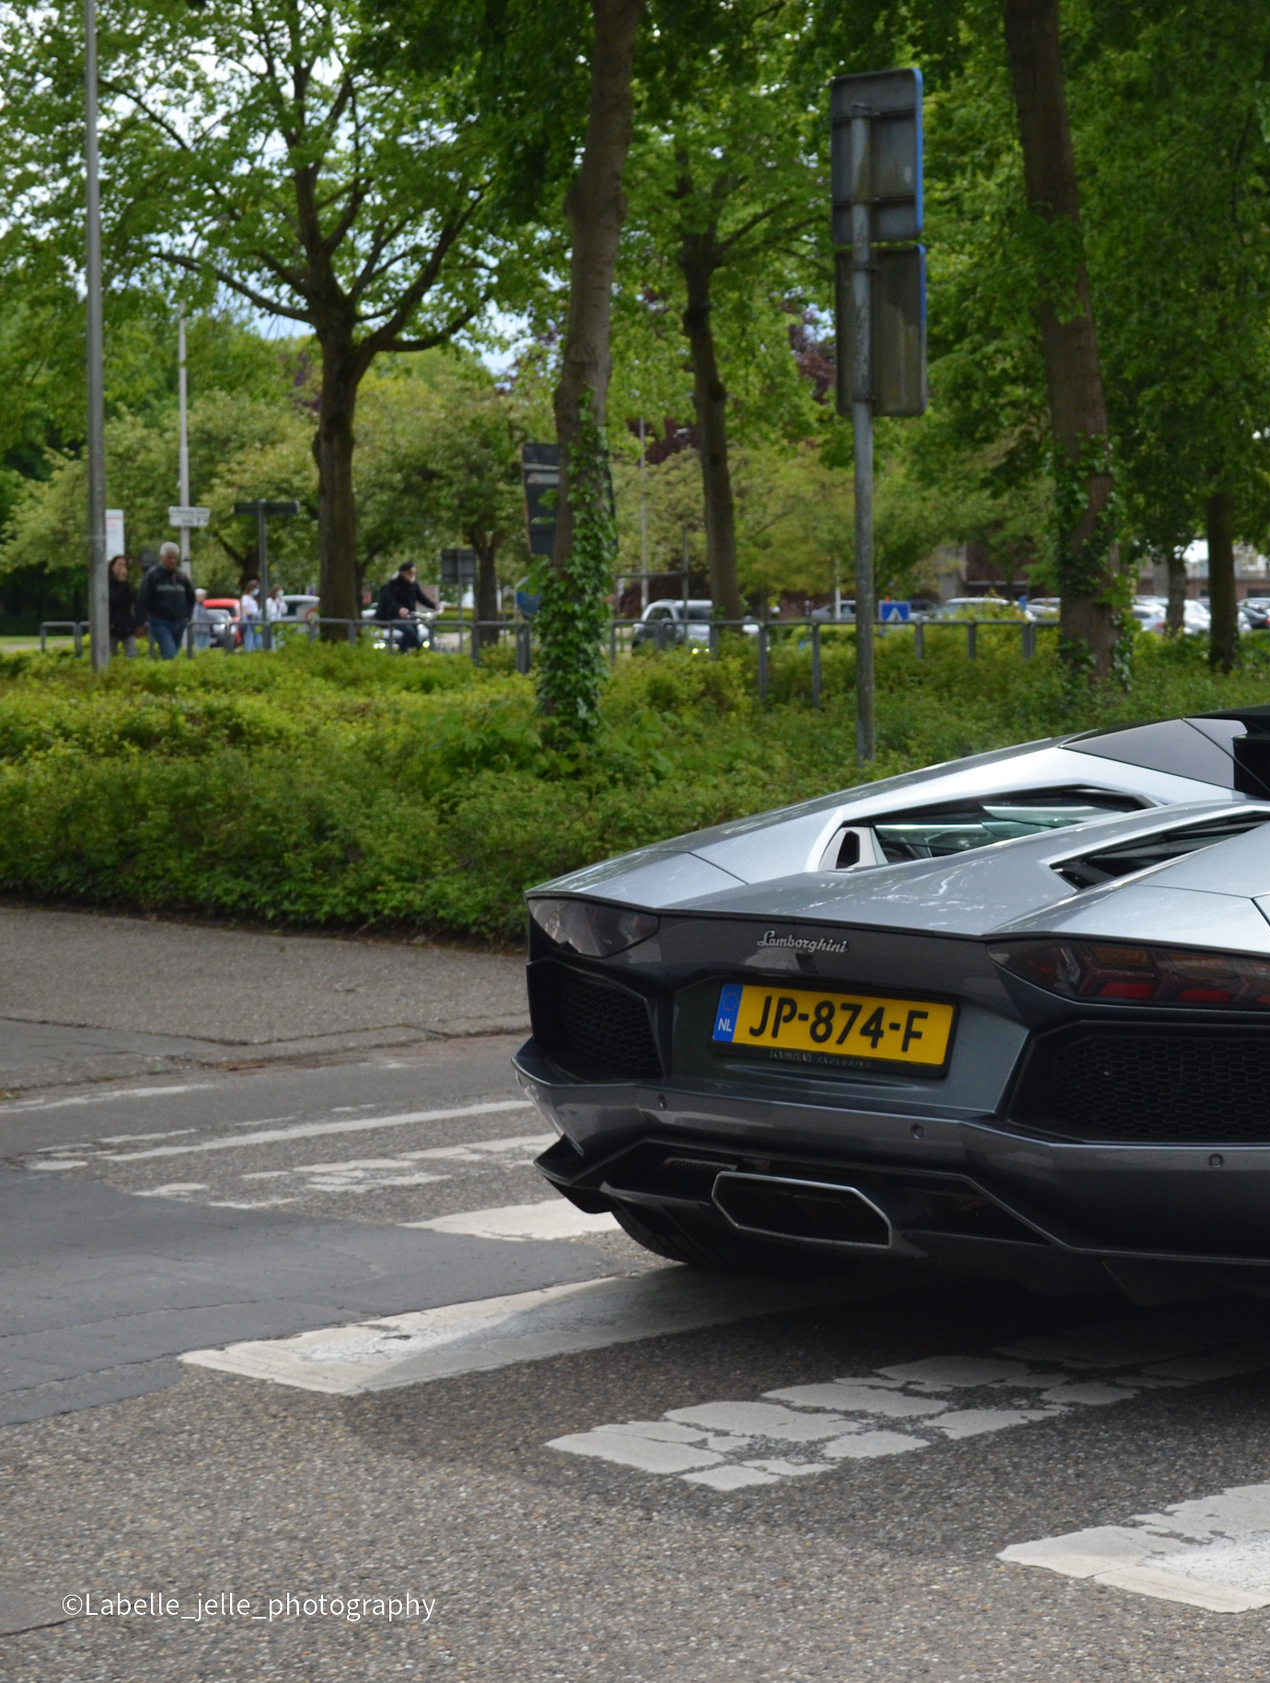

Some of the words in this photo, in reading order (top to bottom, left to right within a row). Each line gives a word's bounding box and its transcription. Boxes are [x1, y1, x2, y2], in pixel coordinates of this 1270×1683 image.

[757, 930, 848, 954] Lamborghini
[717, 1017, 733, 1033] NL
[748, 995, 929, 1053] JP-874-F
[816, 1056, 872, 1069] EXCLUSIVE
